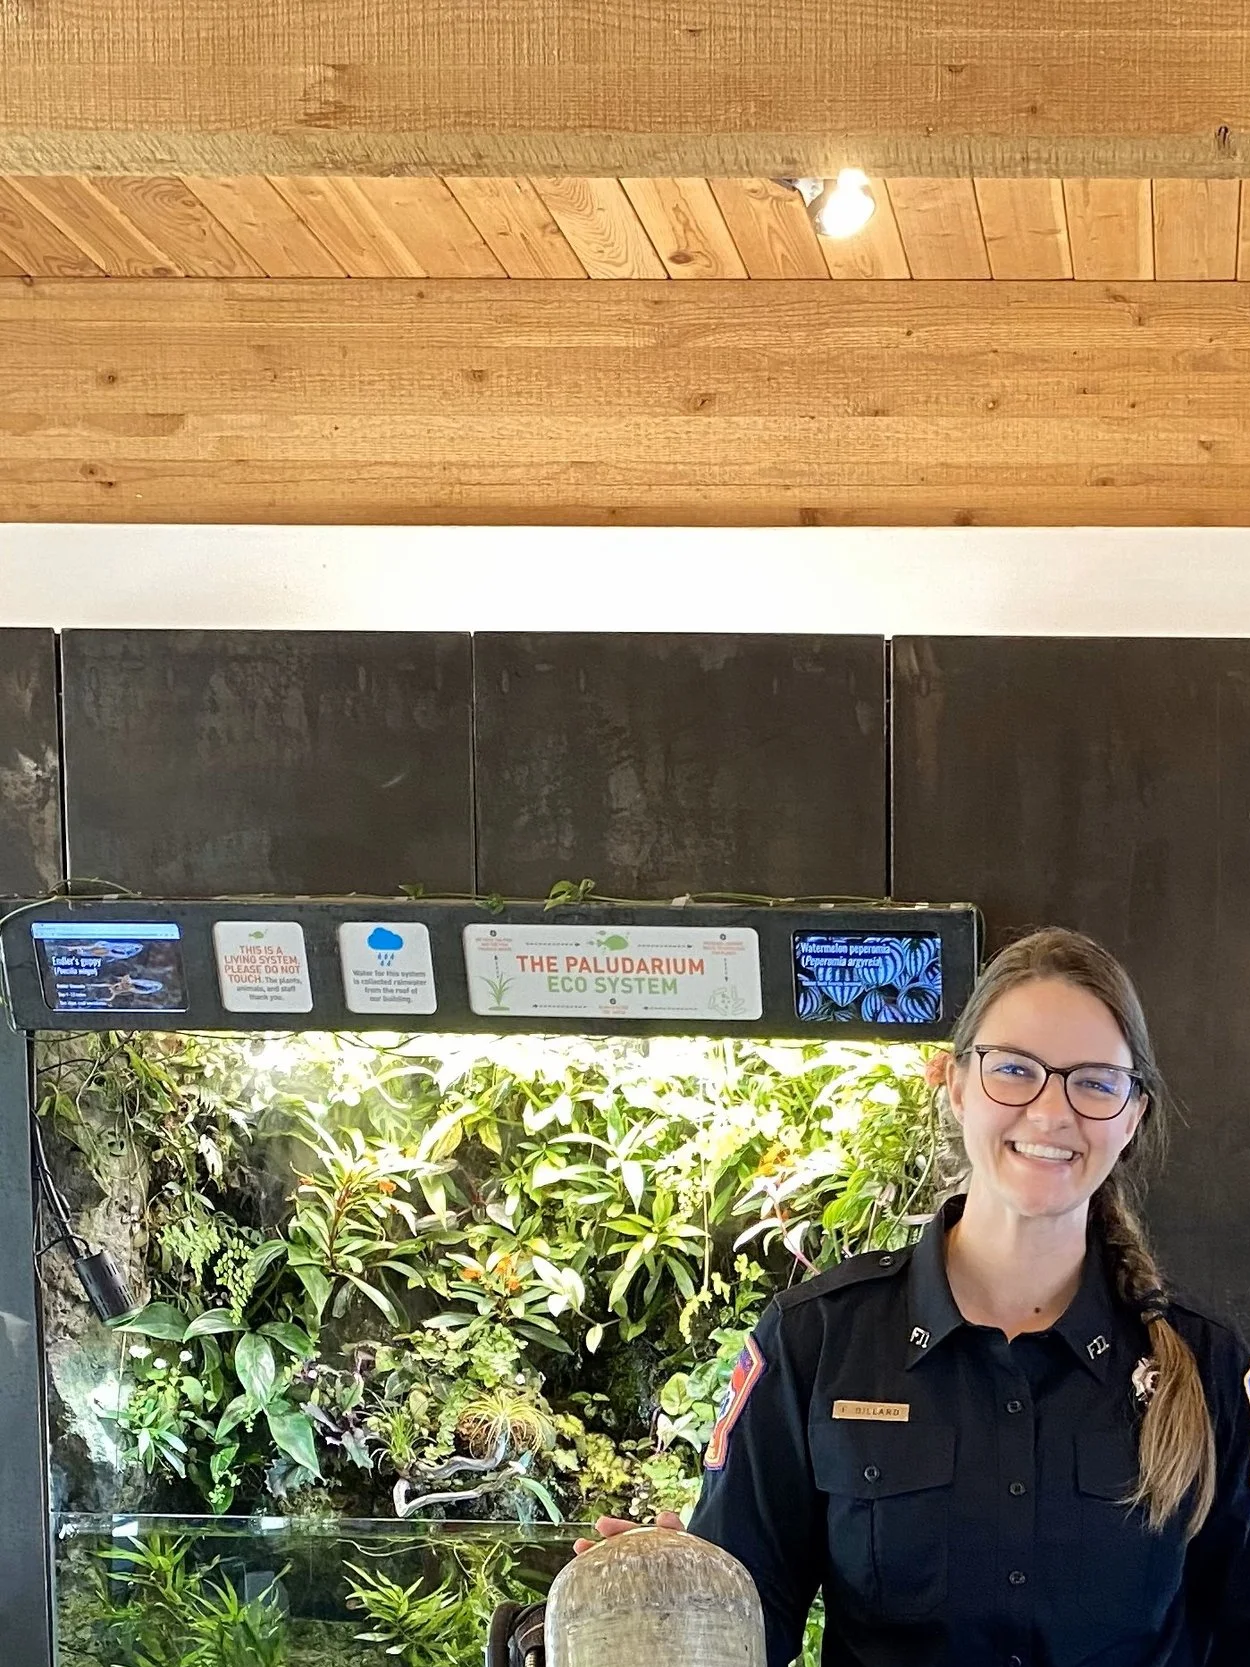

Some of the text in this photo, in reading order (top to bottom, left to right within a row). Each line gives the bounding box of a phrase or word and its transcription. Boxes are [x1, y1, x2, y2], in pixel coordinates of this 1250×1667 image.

[239, 945, 283, 955] THIS IS A
[800, 942, 891, 955] Watermelon peperomia
[224, 955, 300, 965] LIVING SYSTEM.
[516, 955, 704, 975] THE PALUDARIUM
[224, 965, 300, 974] PLEASE DO NOT
[547, 975, 678, 995] ECO SYSTEM
[1086, 1335, 1110, 1360] FD
